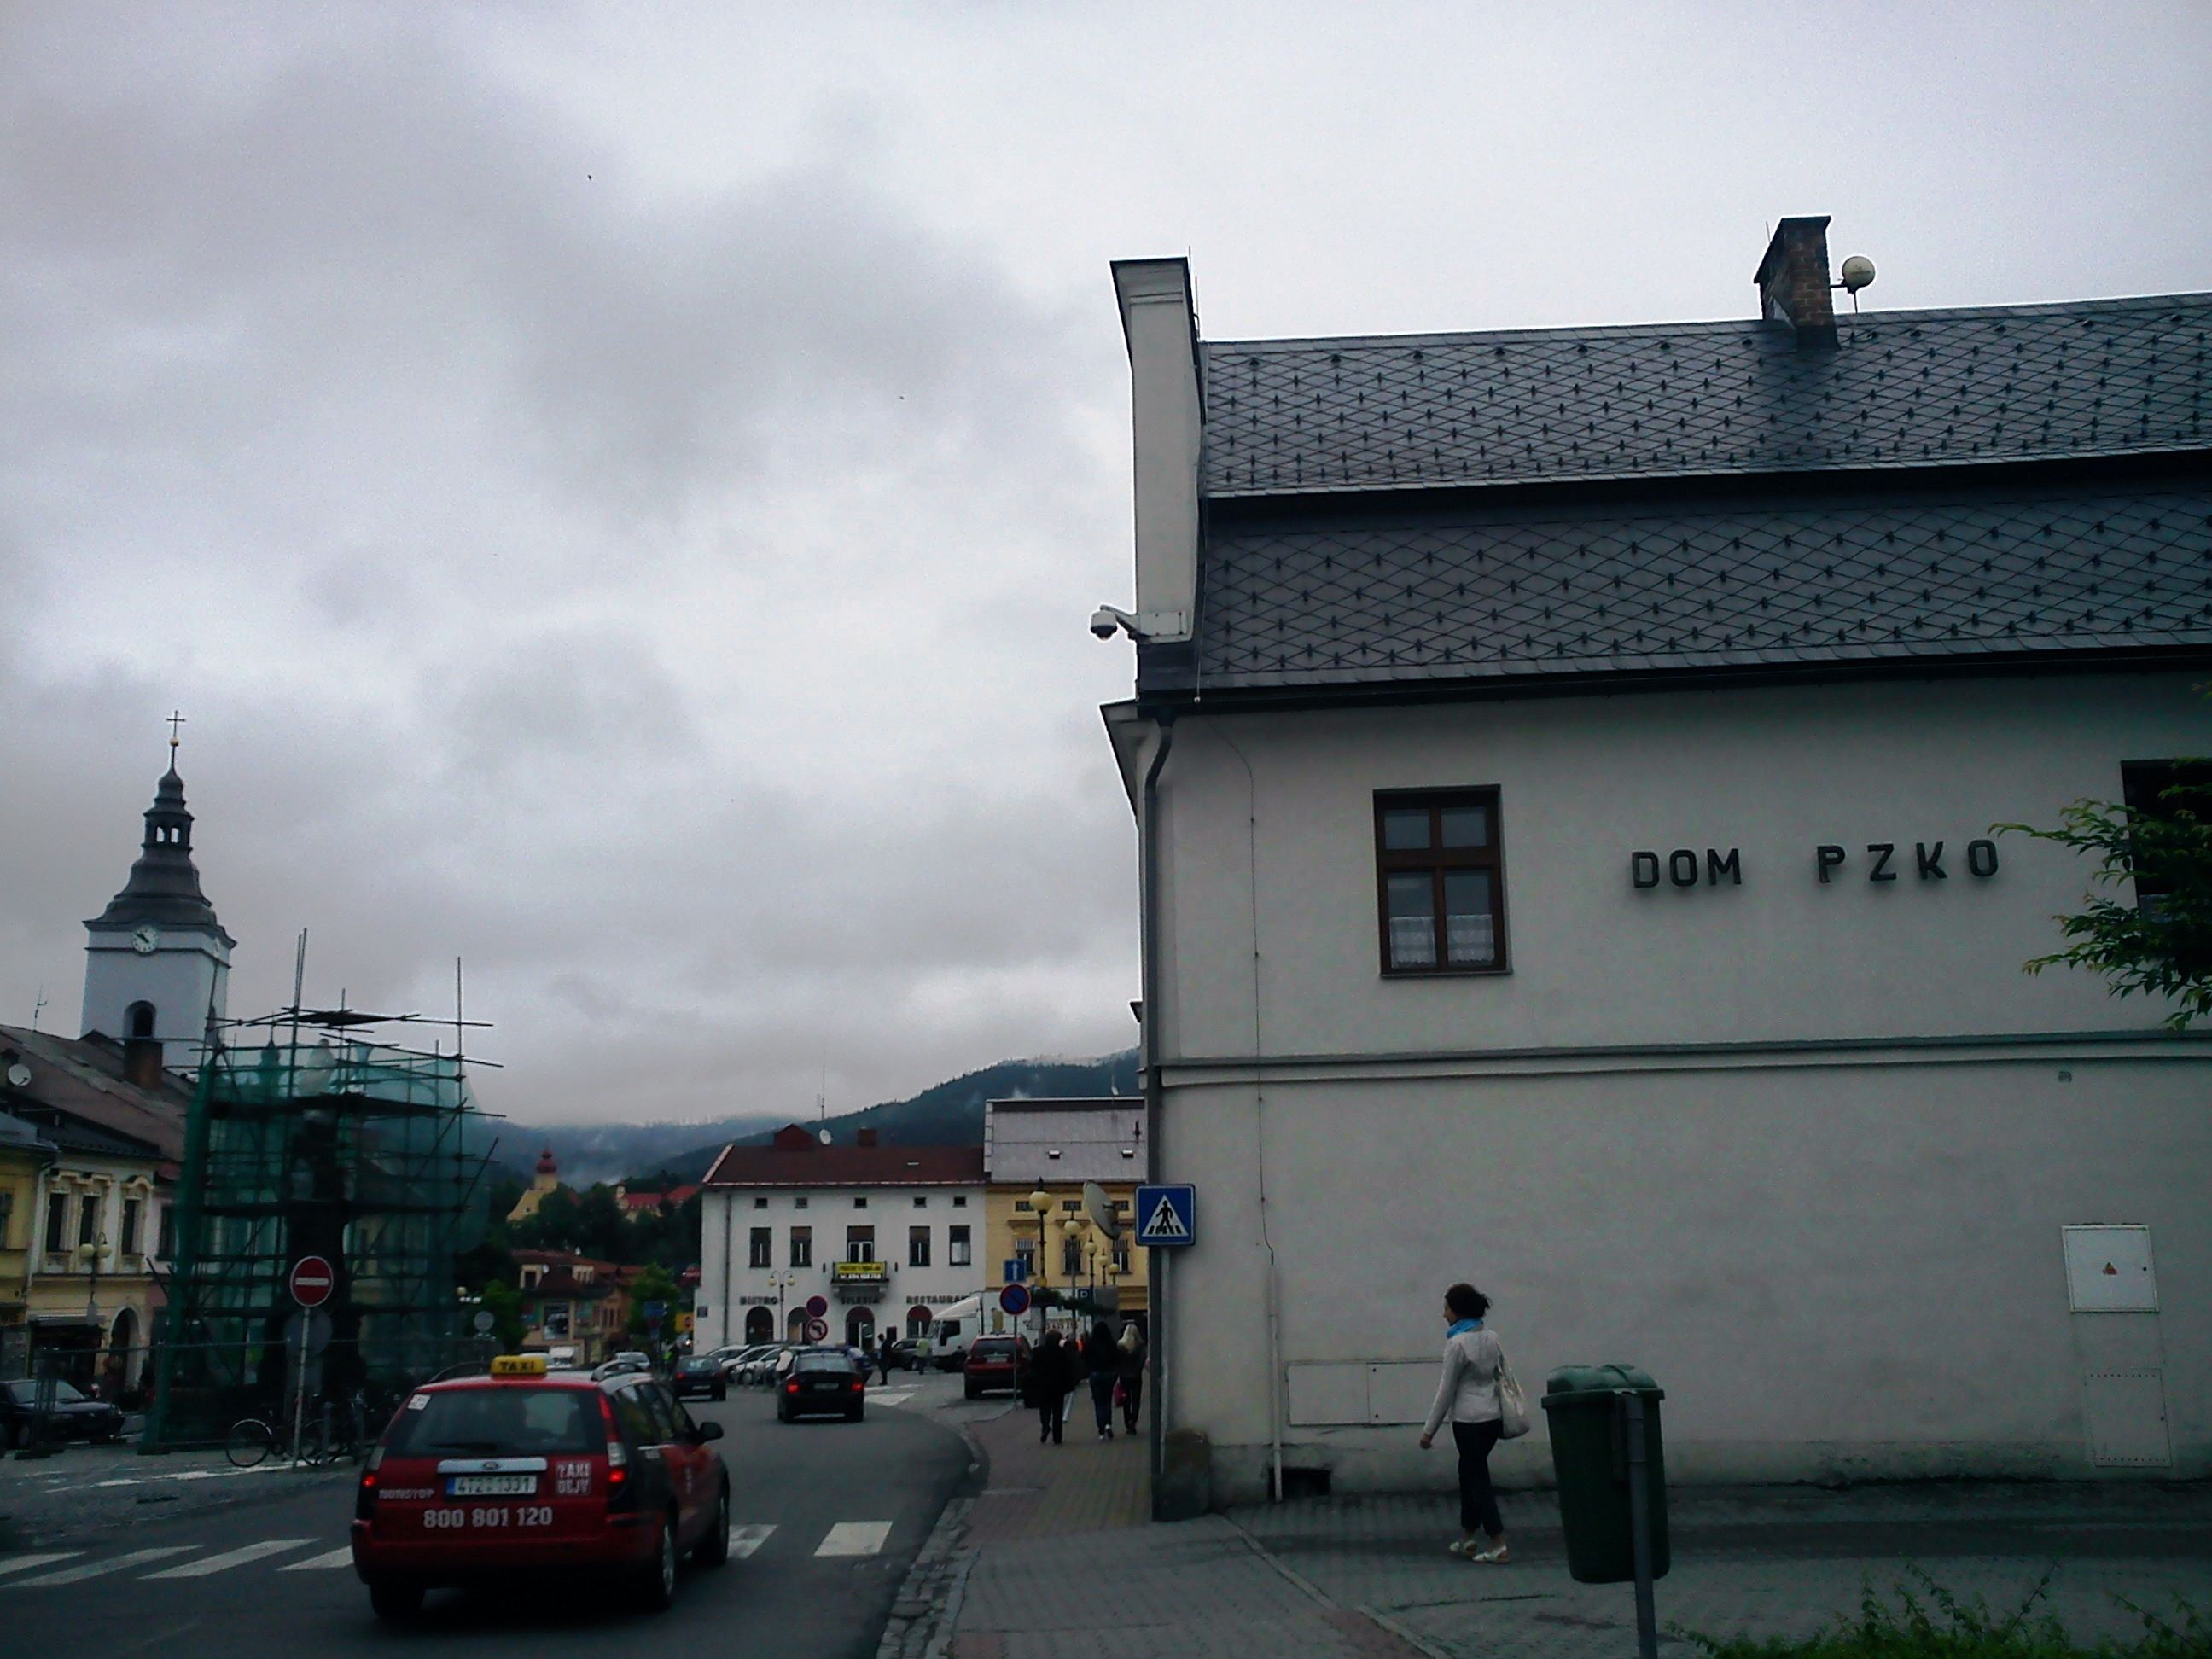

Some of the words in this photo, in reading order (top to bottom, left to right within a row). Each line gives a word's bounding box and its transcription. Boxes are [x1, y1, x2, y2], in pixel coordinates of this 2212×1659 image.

[1632, 847, 1742, 888] DOM
[1816, 839, 1999, 884] PZKO
[498, 1360, 535, 1371] TAXI
[556, 1461, 590, 1478] TAXI
[422, 1508, 465, 1529] 800
[471, 1507, 509, 1528] 801
[515, 1506, 554, 1527] 120
